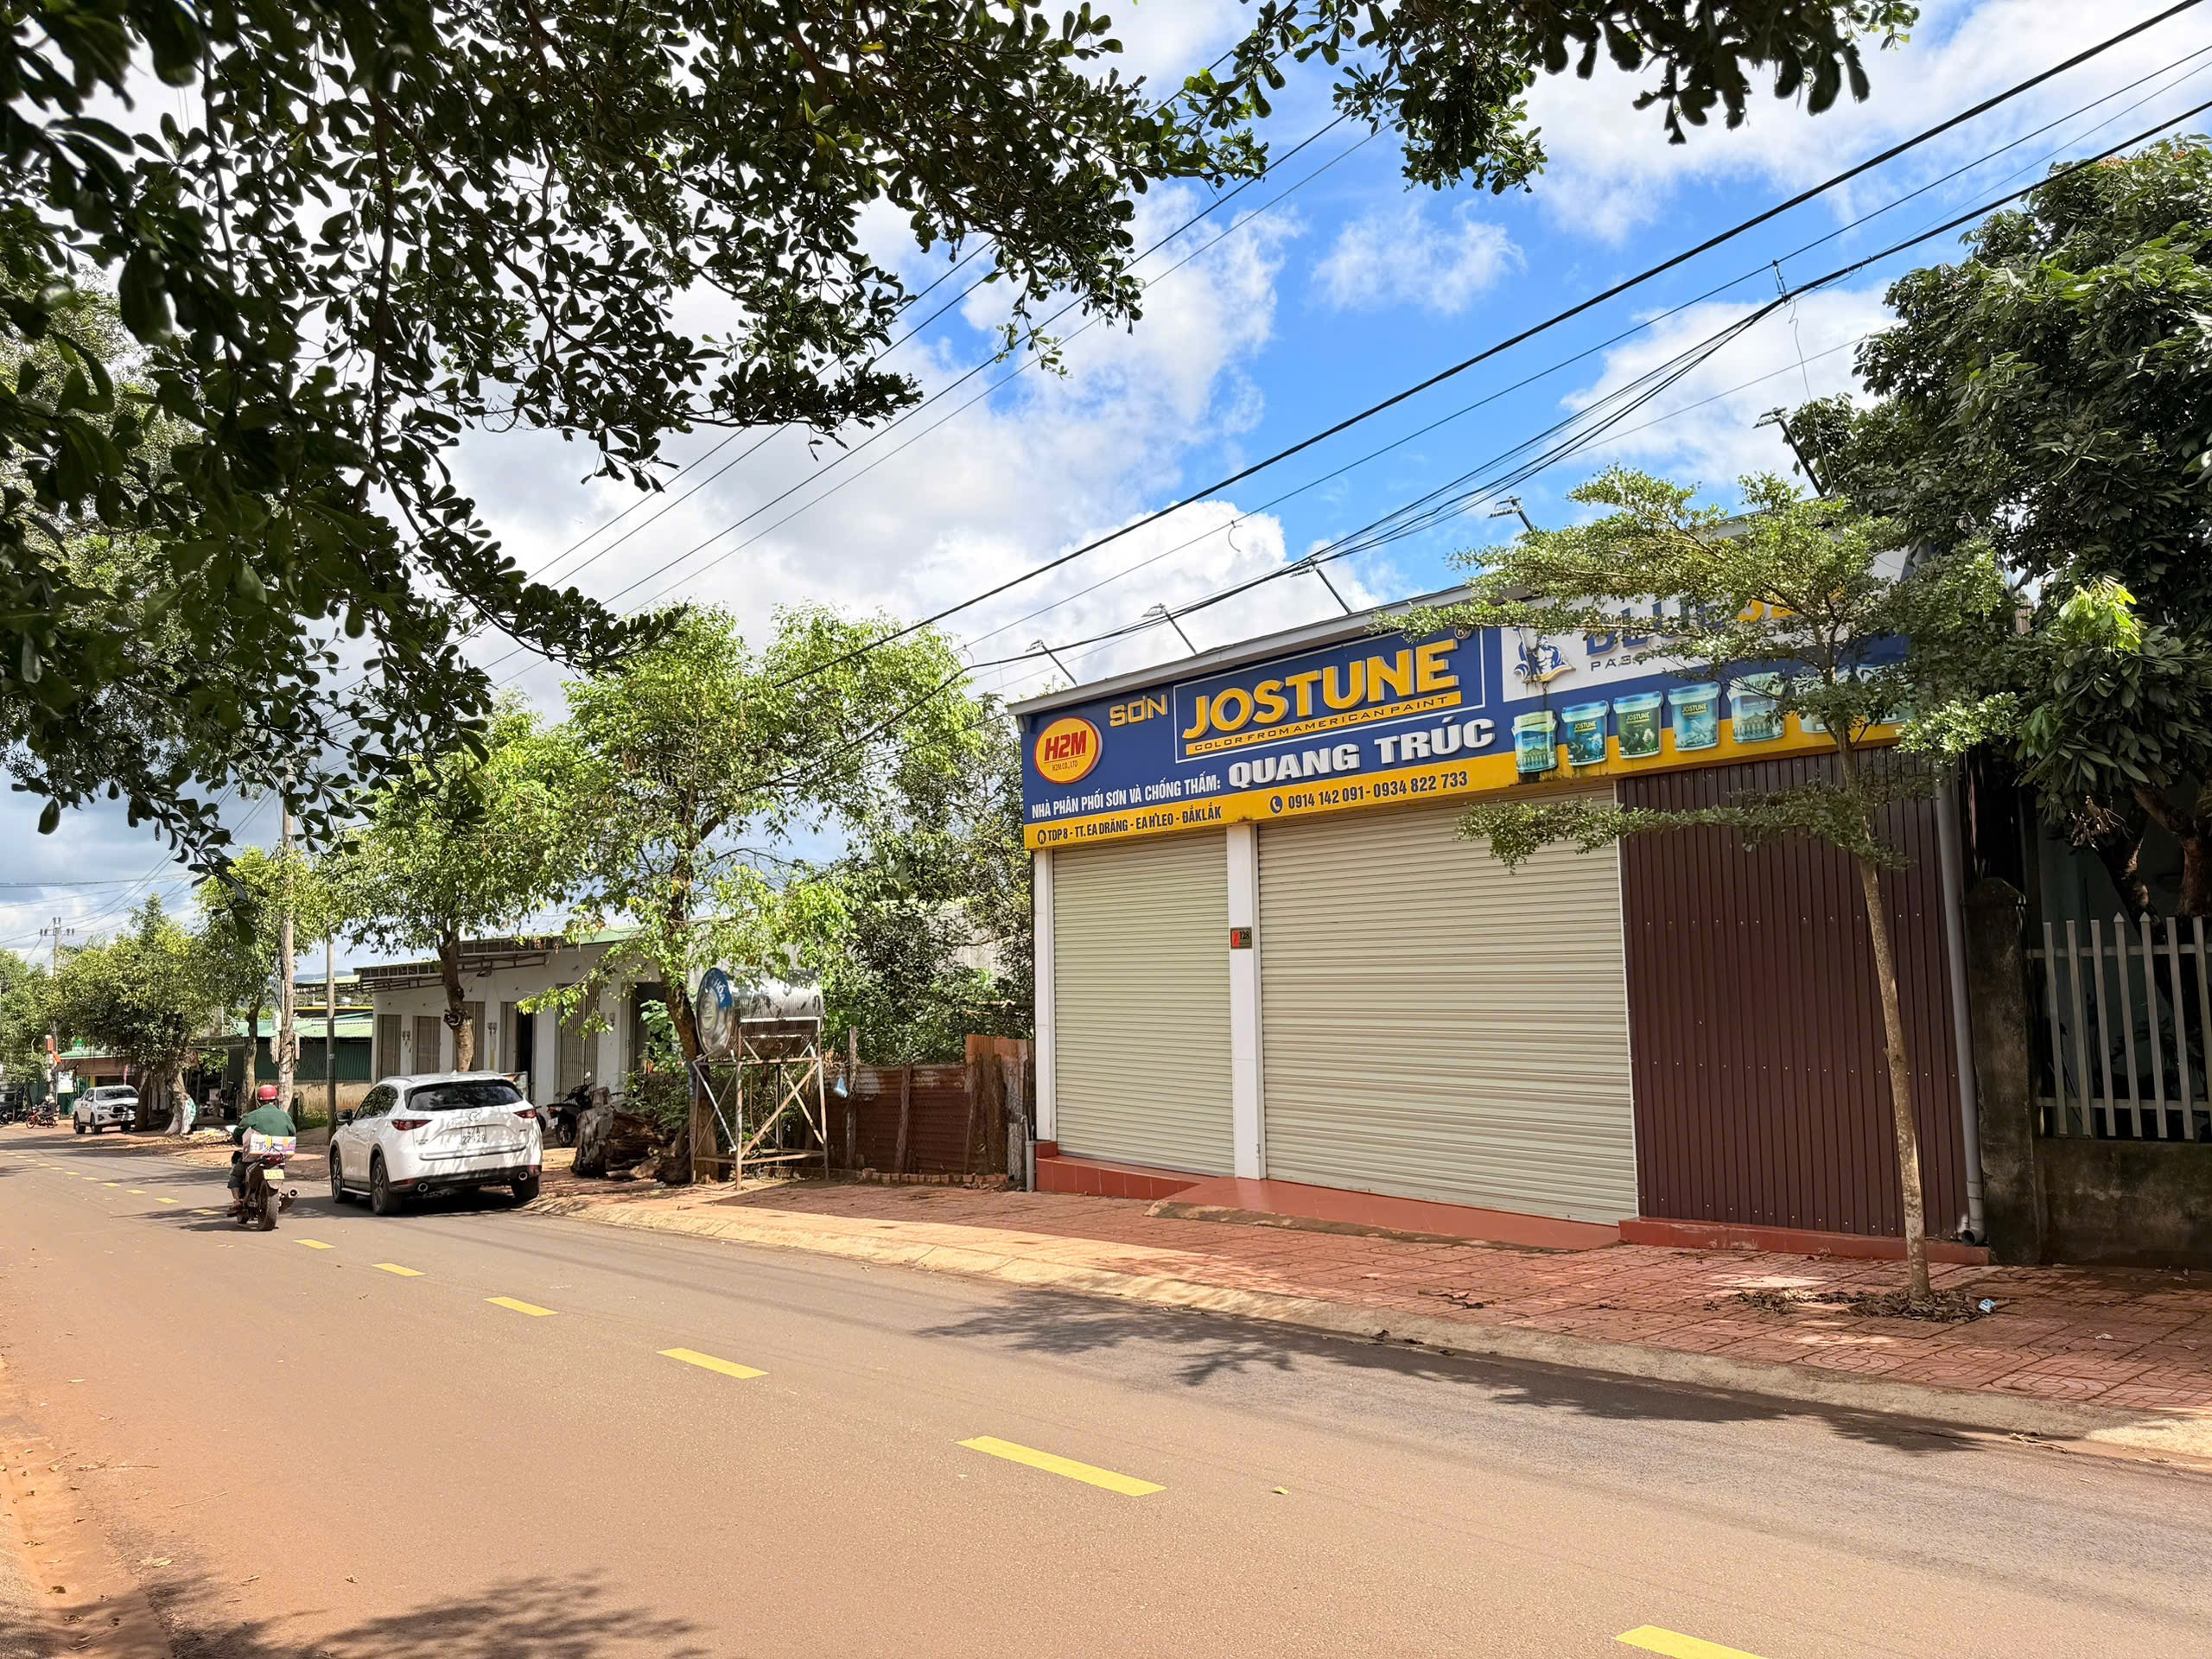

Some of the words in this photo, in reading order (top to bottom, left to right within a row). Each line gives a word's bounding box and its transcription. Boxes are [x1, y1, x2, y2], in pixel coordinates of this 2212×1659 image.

[1181, 639, 1459, 740] JOSTUNE
[1109, 694, 1168, 727] SƠN
[1194, 737, 1243, 751] COLOR
[1248, 728, 1289, 741] FROM
[1293, 709, 1384, 732] AMERICAN
[1390, 696, 1448, 715] PAINT
[1044, 730, 1087, 761] H2M
[1032, 799, 1052, 819] NHÀ
[1053, 796, 1078, 815] PHÂN
[1081, 788, 1103, 811] PHỐI
[1106, 789, 1127, 807] SƠN
[1129, 784, 1142, 804] VÀ
[1144, 777, 1181, 801] CHỐNG
[1184, 771, 1221, 795] THẤM:
[1229, 743, 1360, 790] QUANG
[1374, 715, 1496, 764] TRÚC
[1288, 793, 1315, 810] 0914
[1319, 790, 1339, 805] 142
[1342, 785, 1363, 802] 091
[1373, 780, 1407, 798] 0934
[1410, 775, 1436, 792] 822
[1440, 771, 1467, 788] 733
[1087, 823, 1097, 836] EA
[1099, 818, 1128, 835] DRĂNG
